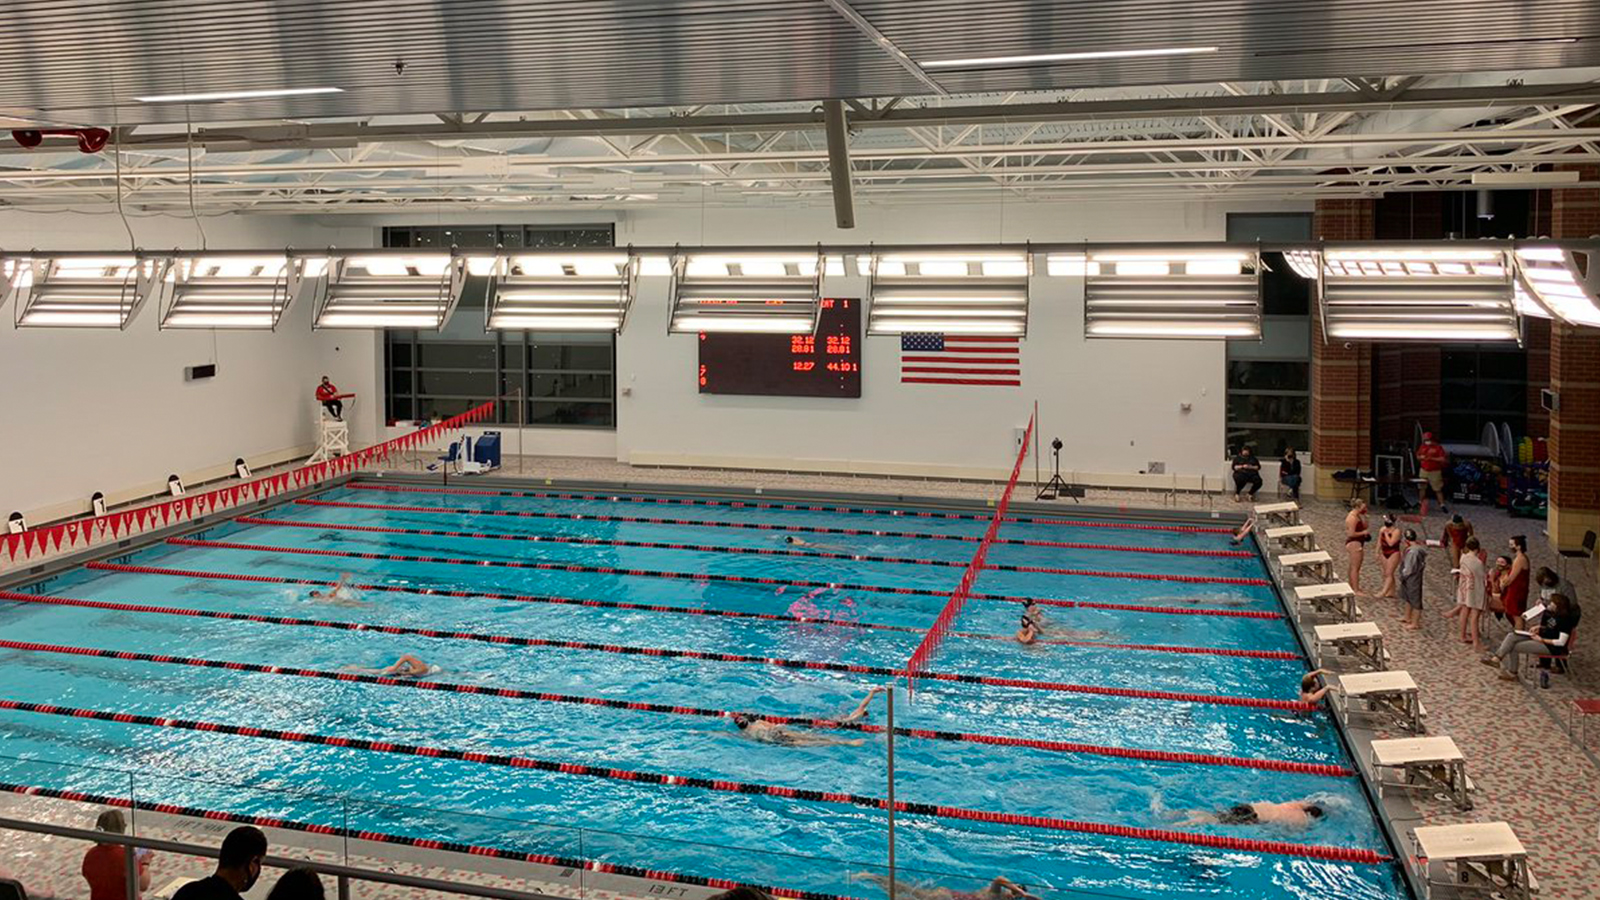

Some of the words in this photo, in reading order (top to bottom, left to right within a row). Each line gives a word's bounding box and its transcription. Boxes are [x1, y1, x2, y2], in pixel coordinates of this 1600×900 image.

[843, 299, 849, 309] 1
[826, 335, 851, 345] 32.12
[793, 361, 815, 371] 12.27
[826, 362, 851, 371] 44.10
[1370, 701, 1377, 712] 6
[1408, 774, 1415, 785] 7
[1461, 871, 1469, 883] 8
[649, 884, 666, 895] 13
[667, 886, 689, 897] FT
